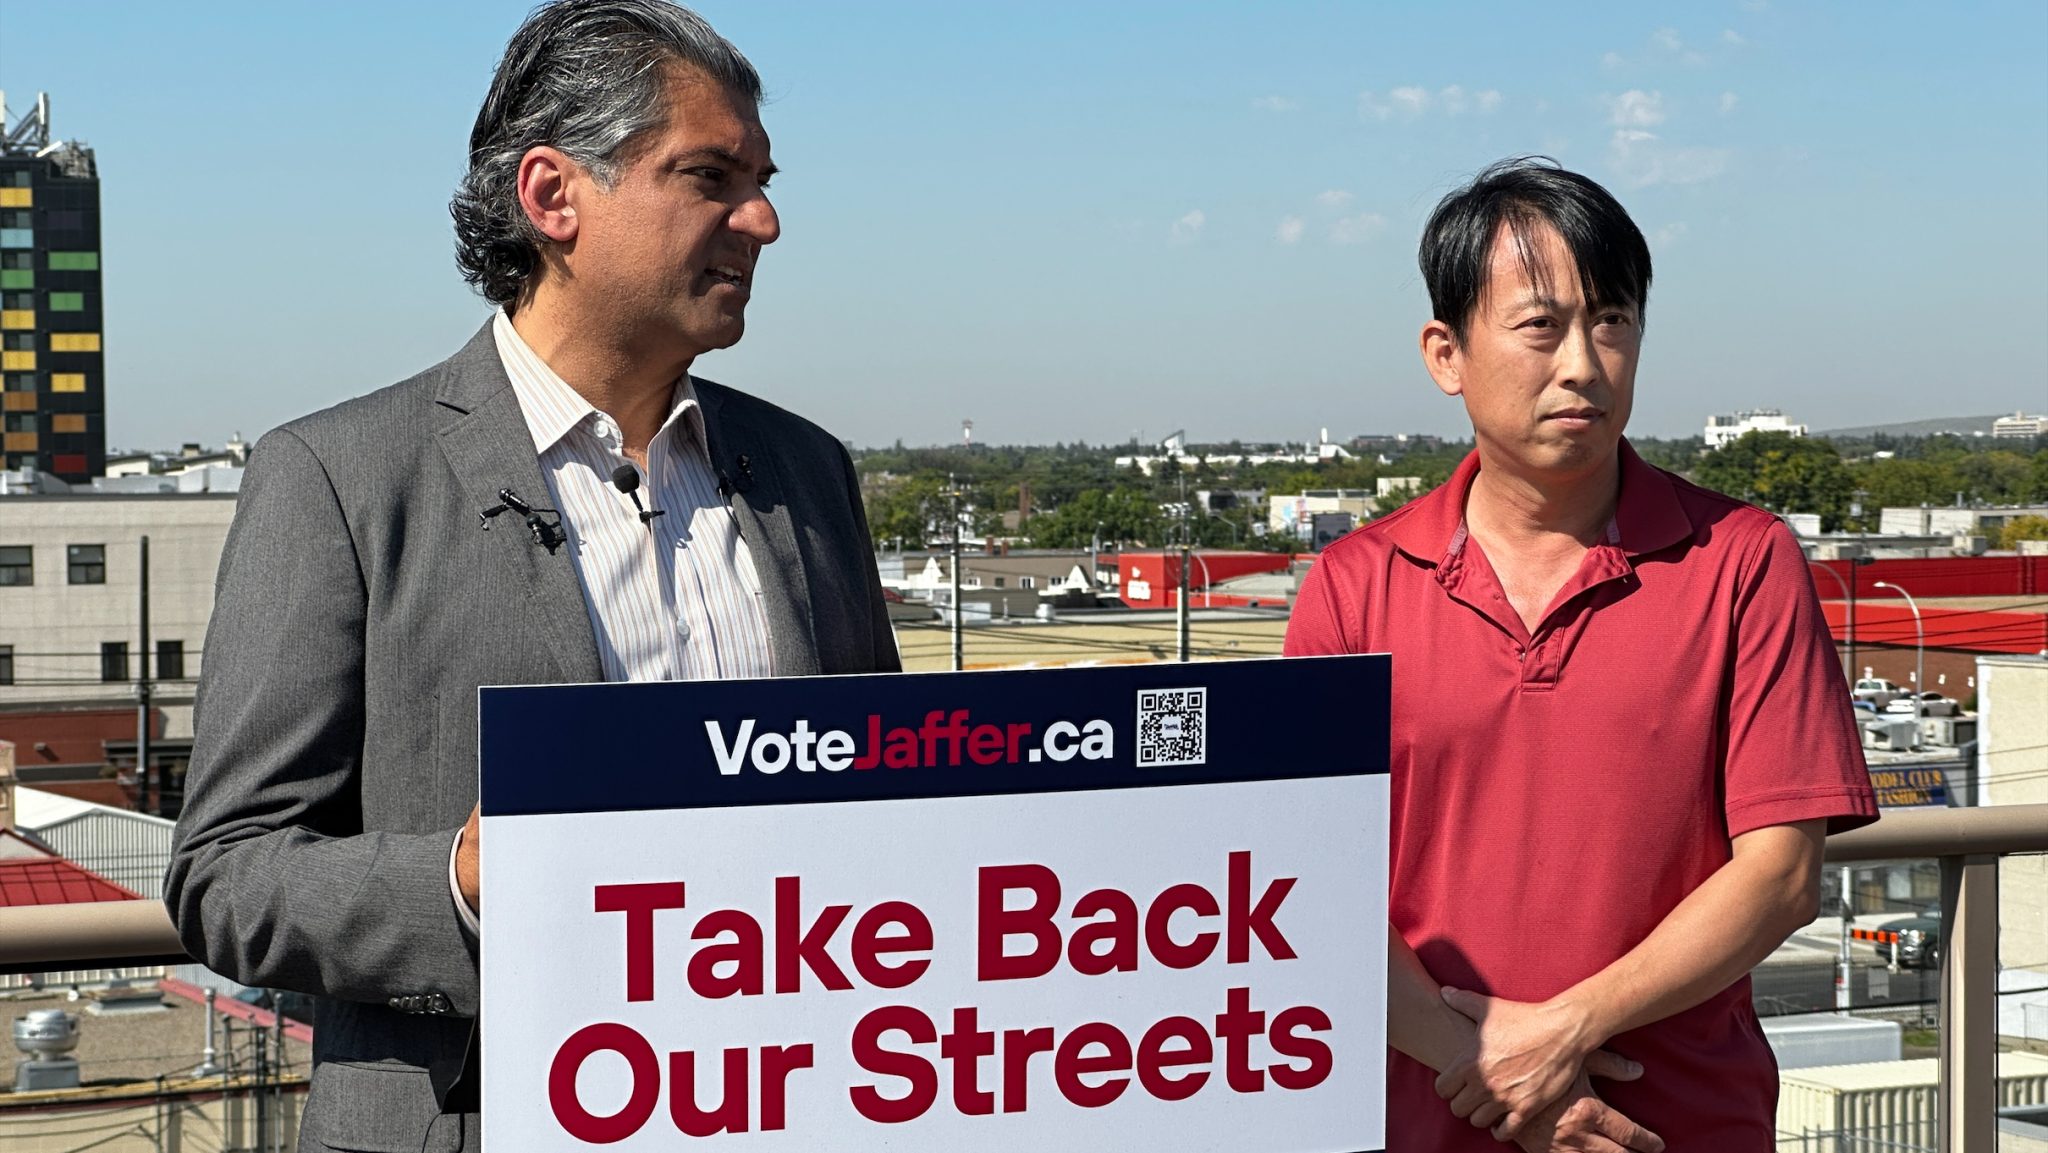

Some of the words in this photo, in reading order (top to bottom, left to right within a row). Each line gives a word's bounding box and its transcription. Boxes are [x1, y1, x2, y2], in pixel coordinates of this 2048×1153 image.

[704, 709, 1114, 776] VoteJaffer.ca
[1869, 772, 1906, 788] ODEL
[1909, 768, 1942, 787] CLUB
[1877, 788, 1933, 806] FASHION
[594, 876, 934, 1003] Take
[977, 851, 1297, 982] Back
[548, 1022, 814, 1145] Our
[849, 987, 1333, 1123] Streets
